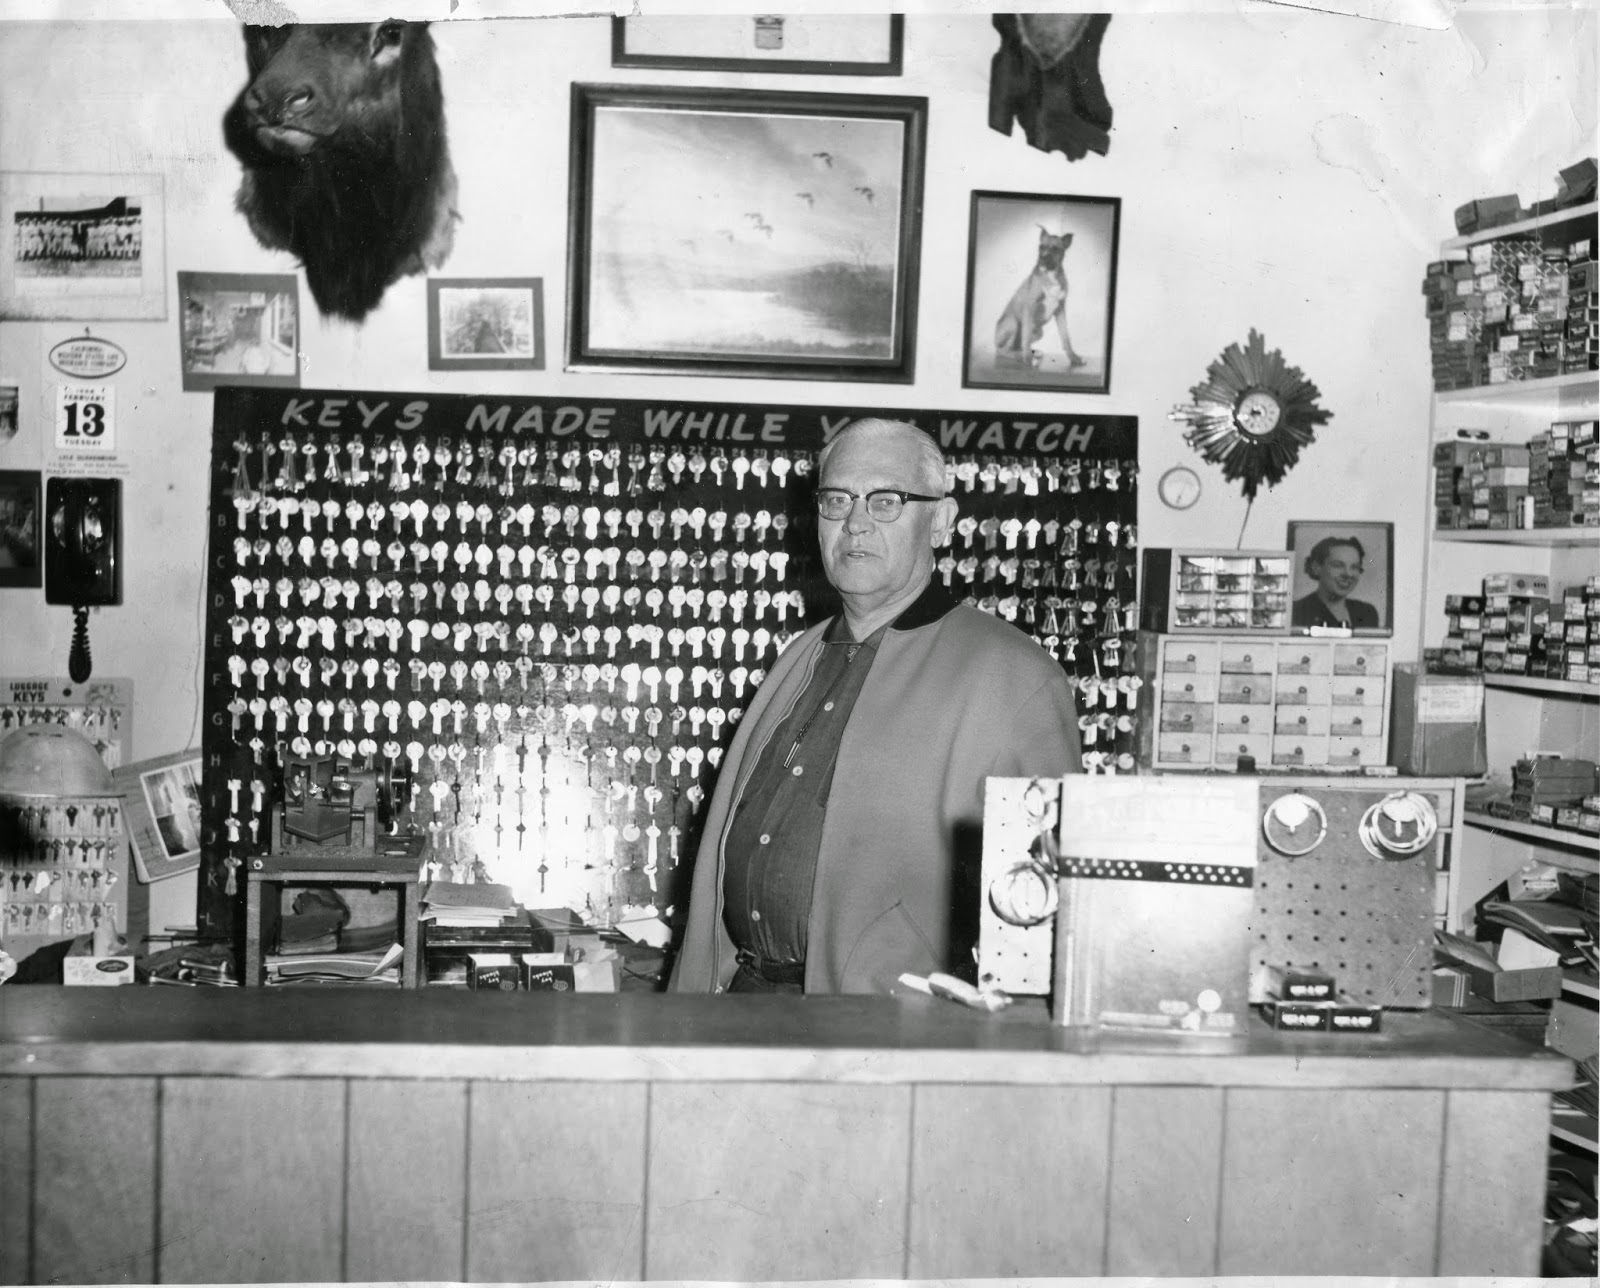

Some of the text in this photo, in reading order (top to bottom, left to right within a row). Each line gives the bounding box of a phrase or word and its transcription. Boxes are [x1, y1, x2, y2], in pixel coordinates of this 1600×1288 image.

[63, 402, 105, 437] 13
[282, 398, 429, 430] KEYS
[465, 404, 616, 438] MADE
[643, 408, 790, 443] WHILE
[940, 419, 1095, 453] WATCH
[218, 514, 227, 526] B
[216, 555, 225, 568] C
[215, 594, 224, 607] D
[213, 634, 222, 647] E
[212, 673, 221, 685] F
[13, 691, 45, 702] KEYS
[212, 712, 223, 726] G
[211, 754, 221, 766] H
[207, 872, 217, 886] K
[206, 912, 215, 925] L
